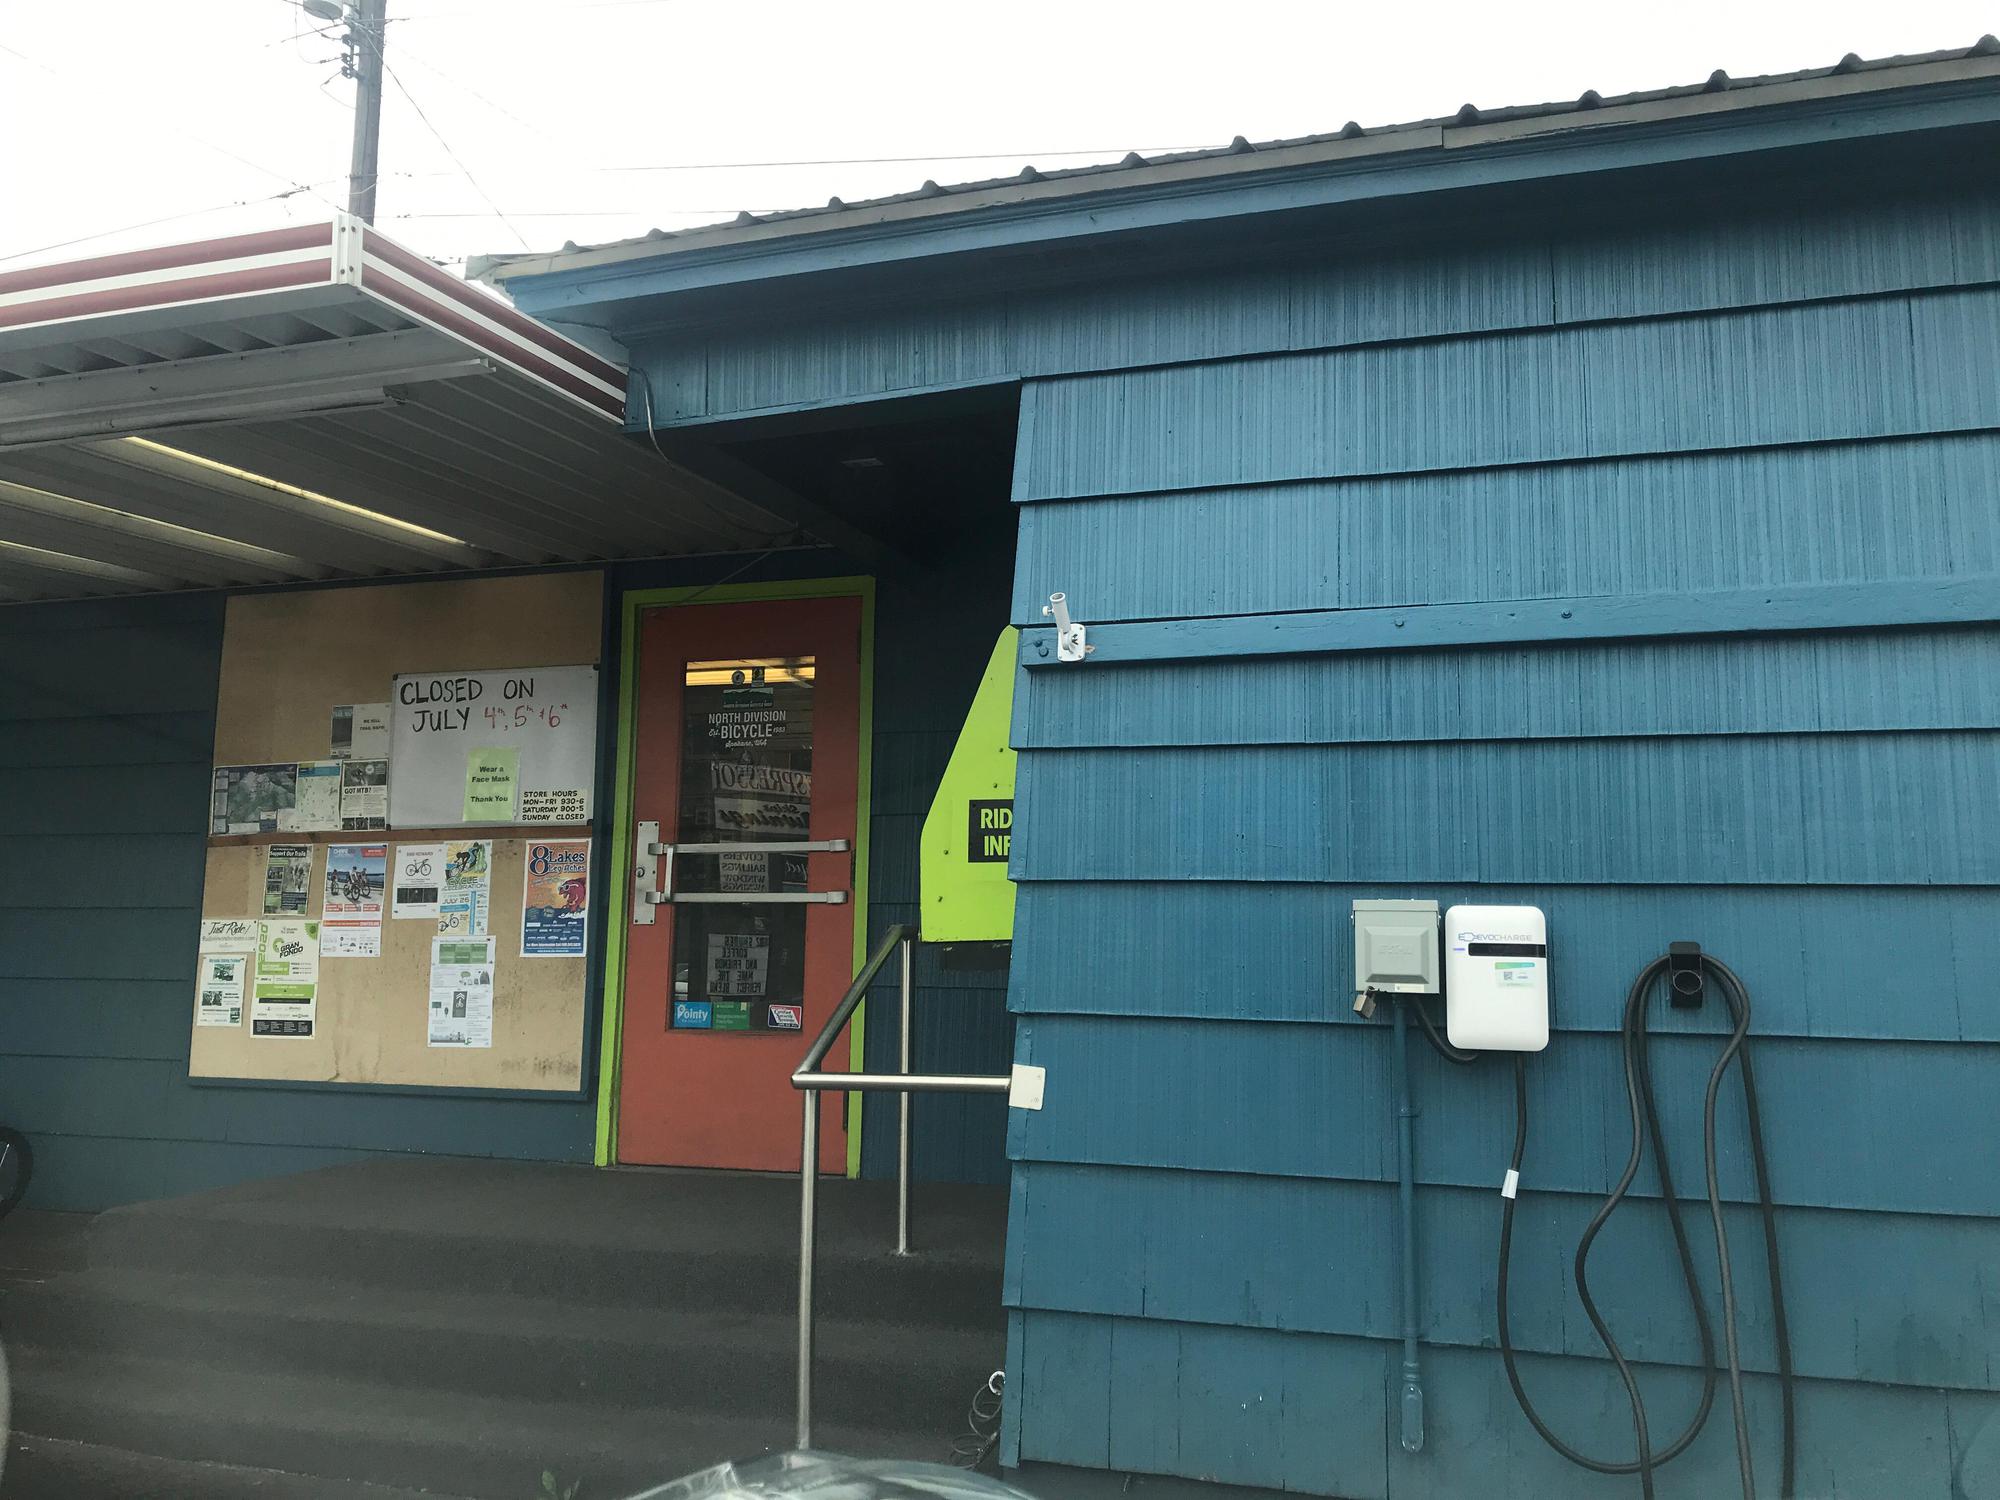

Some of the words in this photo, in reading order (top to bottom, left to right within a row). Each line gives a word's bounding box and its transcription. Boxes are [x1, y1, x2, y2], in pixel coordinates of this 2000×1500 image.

[400, 678, 483, 705] CLOSED
[504, 678, 534, 700] ON
[412, 706, 470, 732] JULY
[708, 712, 741, 724] NORTH
[743, 710, 786, 722] DIVISION
[721, 723, 772, 740] BICYCLE
[529, 844, 551, 876] 8
[549, 850, 586, 863] Lakes
[548, 864, 562, 873] Leg
[562, 864, 586, 872] Aches
[448, 876, 478, 886] CYCLE
[280, 941, 300, 952] GRAN
[280, 946, 304, 958] FONDO
[677, 1004, 708, 1022] Pointy
